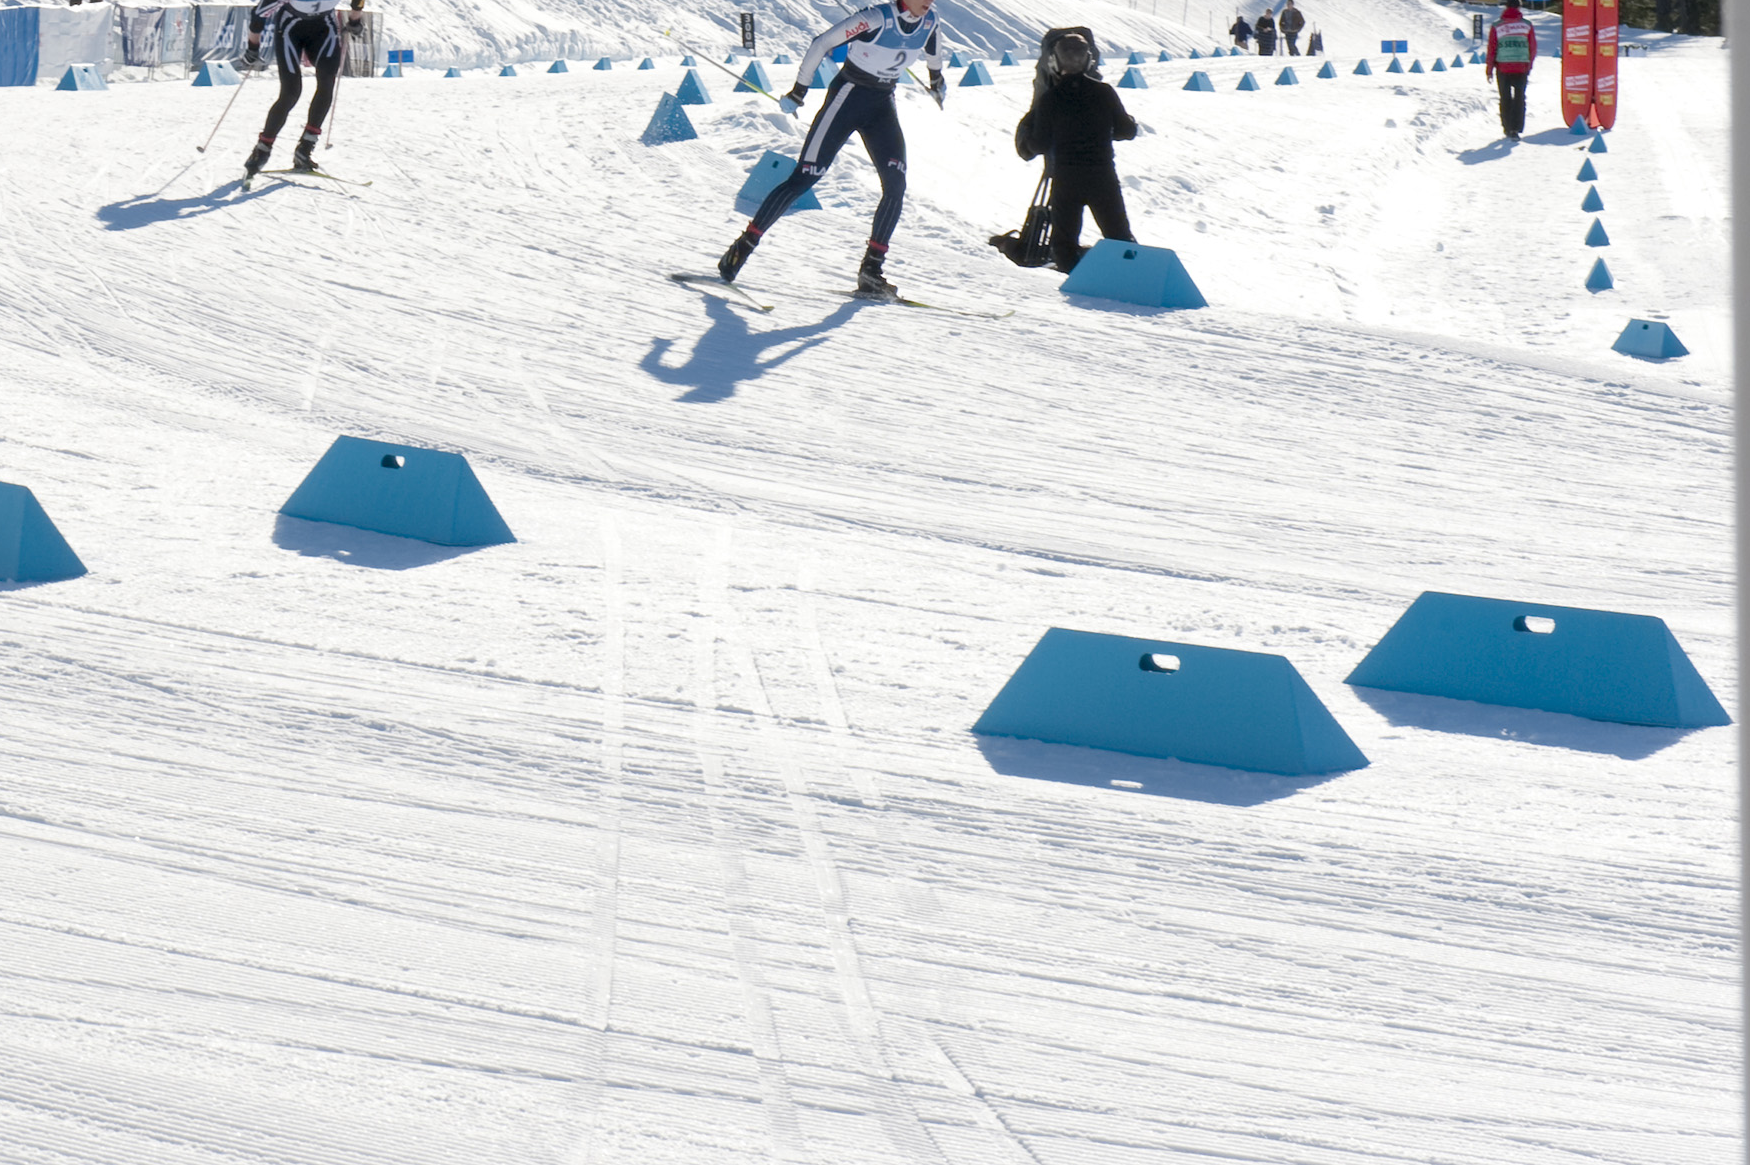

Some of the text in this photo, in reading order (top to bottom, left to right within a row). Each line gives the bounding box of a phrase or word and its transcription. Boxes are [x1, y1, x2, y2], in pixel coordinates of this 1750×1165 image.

[311, 1, 322, 12] 1
[744, 14, 753, 48] 300m
[845, 20, 870, 39] Audi
[886, 50, 907, 72] 2
[802, 164, 828, 176] FILA
[887, 157, 906, 174] FIL
